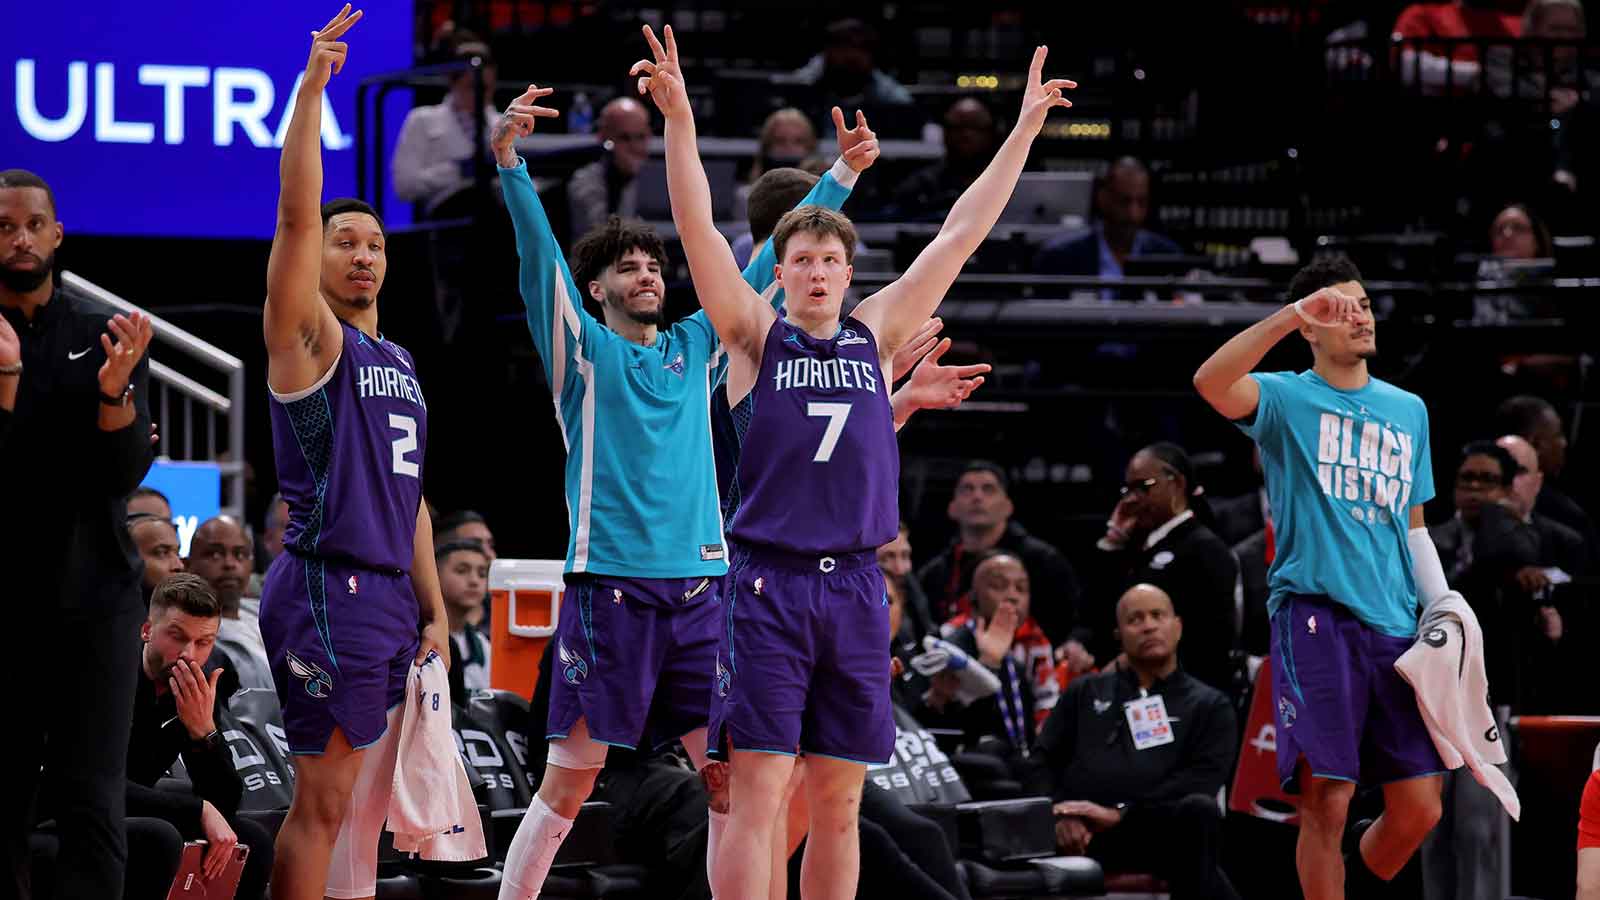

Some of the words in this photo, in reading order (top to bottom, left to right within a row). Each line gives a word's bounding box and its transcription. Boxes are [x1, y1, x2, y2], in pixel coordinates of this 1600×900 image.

[14, 57, 346, 151] ULTRA
[357, 365, 427, 413] HORNET
[773, 356, 878, 394] HORNETS
[388, 412, 420, 478] 2
[806, 401, 853, 462] 7
